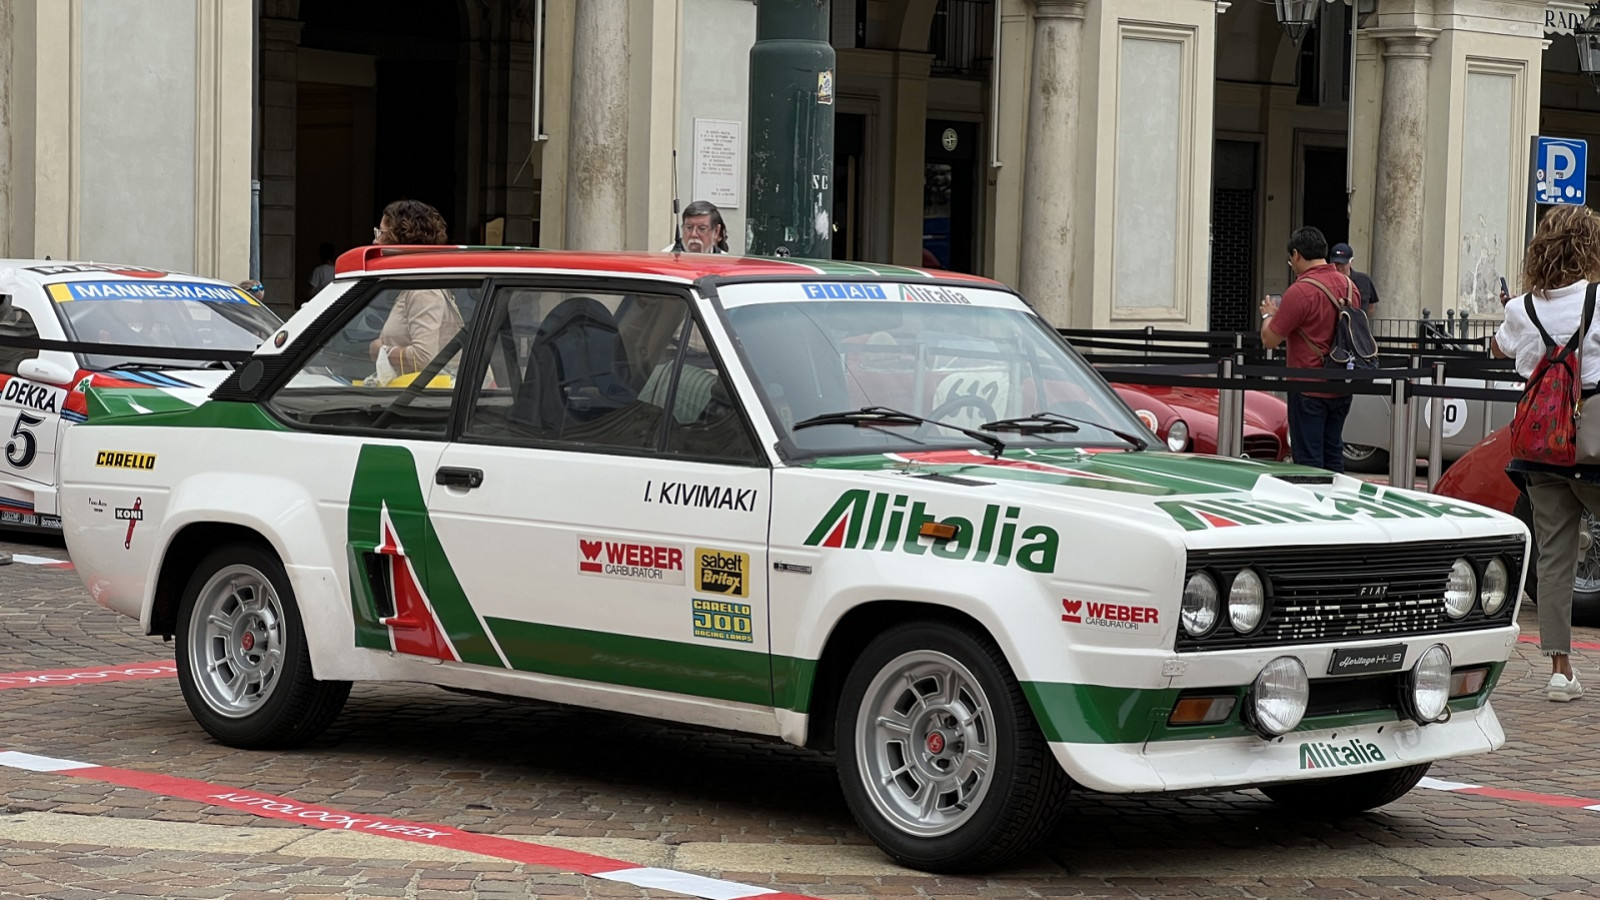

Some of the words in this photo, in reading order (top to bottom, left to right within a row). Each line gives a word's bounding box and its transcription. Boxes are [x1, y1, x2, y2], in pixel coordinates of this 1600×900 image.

[1546, 144, 1576, 197] P
[76, 284, 241, 302] MANNESMANN
[805, 284, 886, 299] FIAT
[899, 284, 972, 305] Alitalia
[4, 380, 58, 414] DEKRA
[5, 410, 46, 470] 5
[96, 452, 156, 470] CARELLO
[643, 480, 653, 503] I.
[658, 482, 758, 512] KIVIMAKI
[115, 508, 142, 520] KONI
[802, 488, 1060, 574] Alitalia
[605, 541, 683, 571] WEBER
[701, 552, 743, 572] sabelt
[604, 563, 663, 580] CARBURATORI
[702, 569, 741, 594] Britax
[1360, 586, 1388, 596] FIAT
[693, 600, 751, 615] CARELLO
[1086, 601, 1160, 624] WEBER
[693, 612, 751, 634] JOD
[1085, 616, 1139, 630] CARBURATORI
[694, 629, 725, 640] RACING
[726, 633, 753, 643] LAMPS
[1339, 655, 1376, 667] Heritage
[1299, 738, 1386, 770] Alitalia
[207, 792, 370, 829] AUTOLOOK
[363, 821, 453, 839] WEEK
